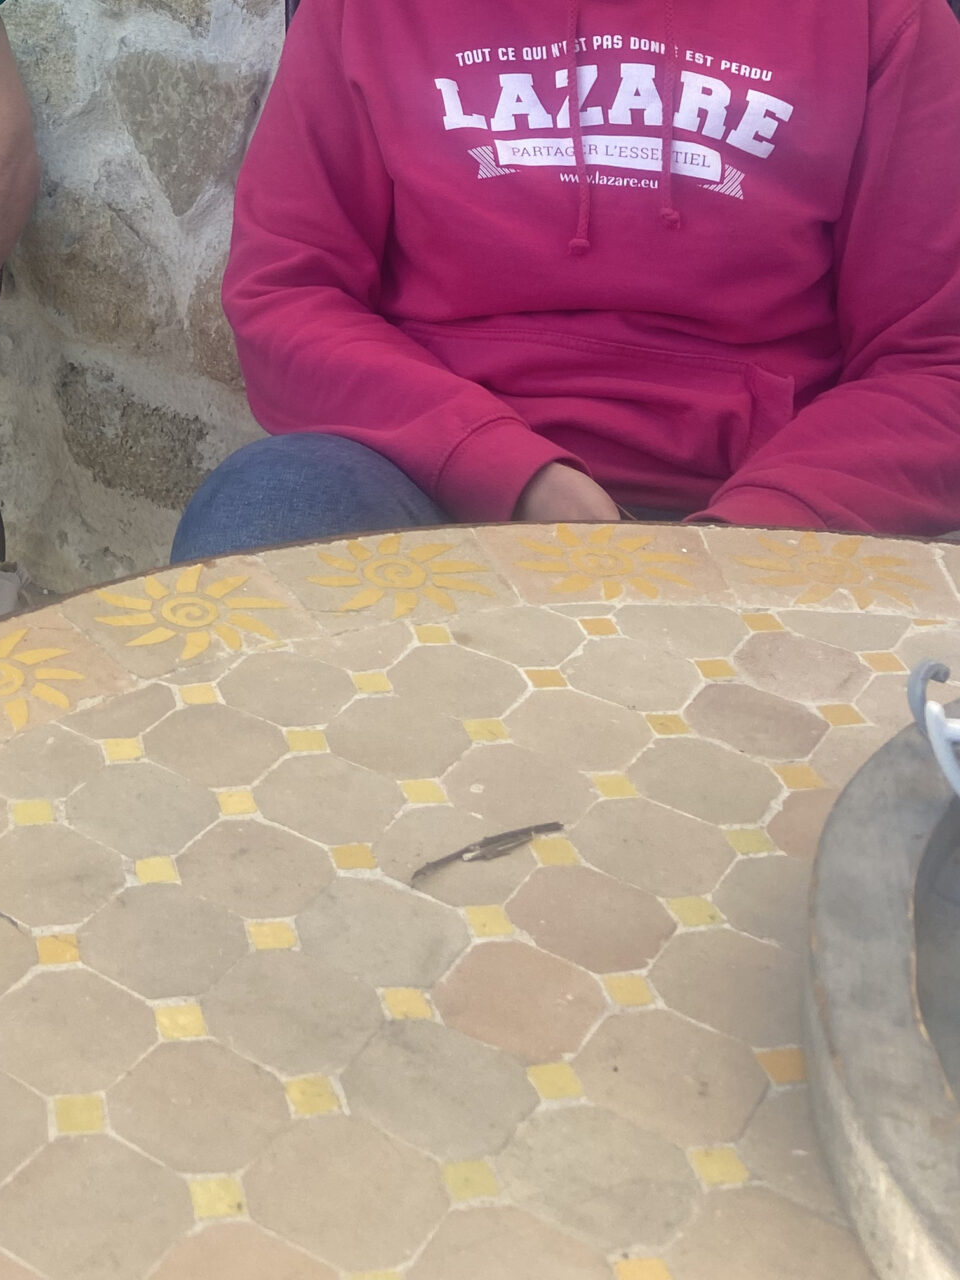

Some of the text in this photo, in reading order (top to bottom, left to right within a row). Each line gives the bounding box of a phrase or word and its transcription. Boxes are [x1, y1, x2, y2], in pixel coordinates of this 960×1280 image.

[456, 47, 492, 67] TOUT
[498, 47, 517, 61] CE
[522, 45, 548, 61] QUI
[593, 35, 623, 50] PAS
[686, 51, 714, 68] EST
[720, 61, 774, 82] PERDU
[434, 62, 795, 159] LAZARE
[605, 144, 712, 169] L'ESSETIEL
